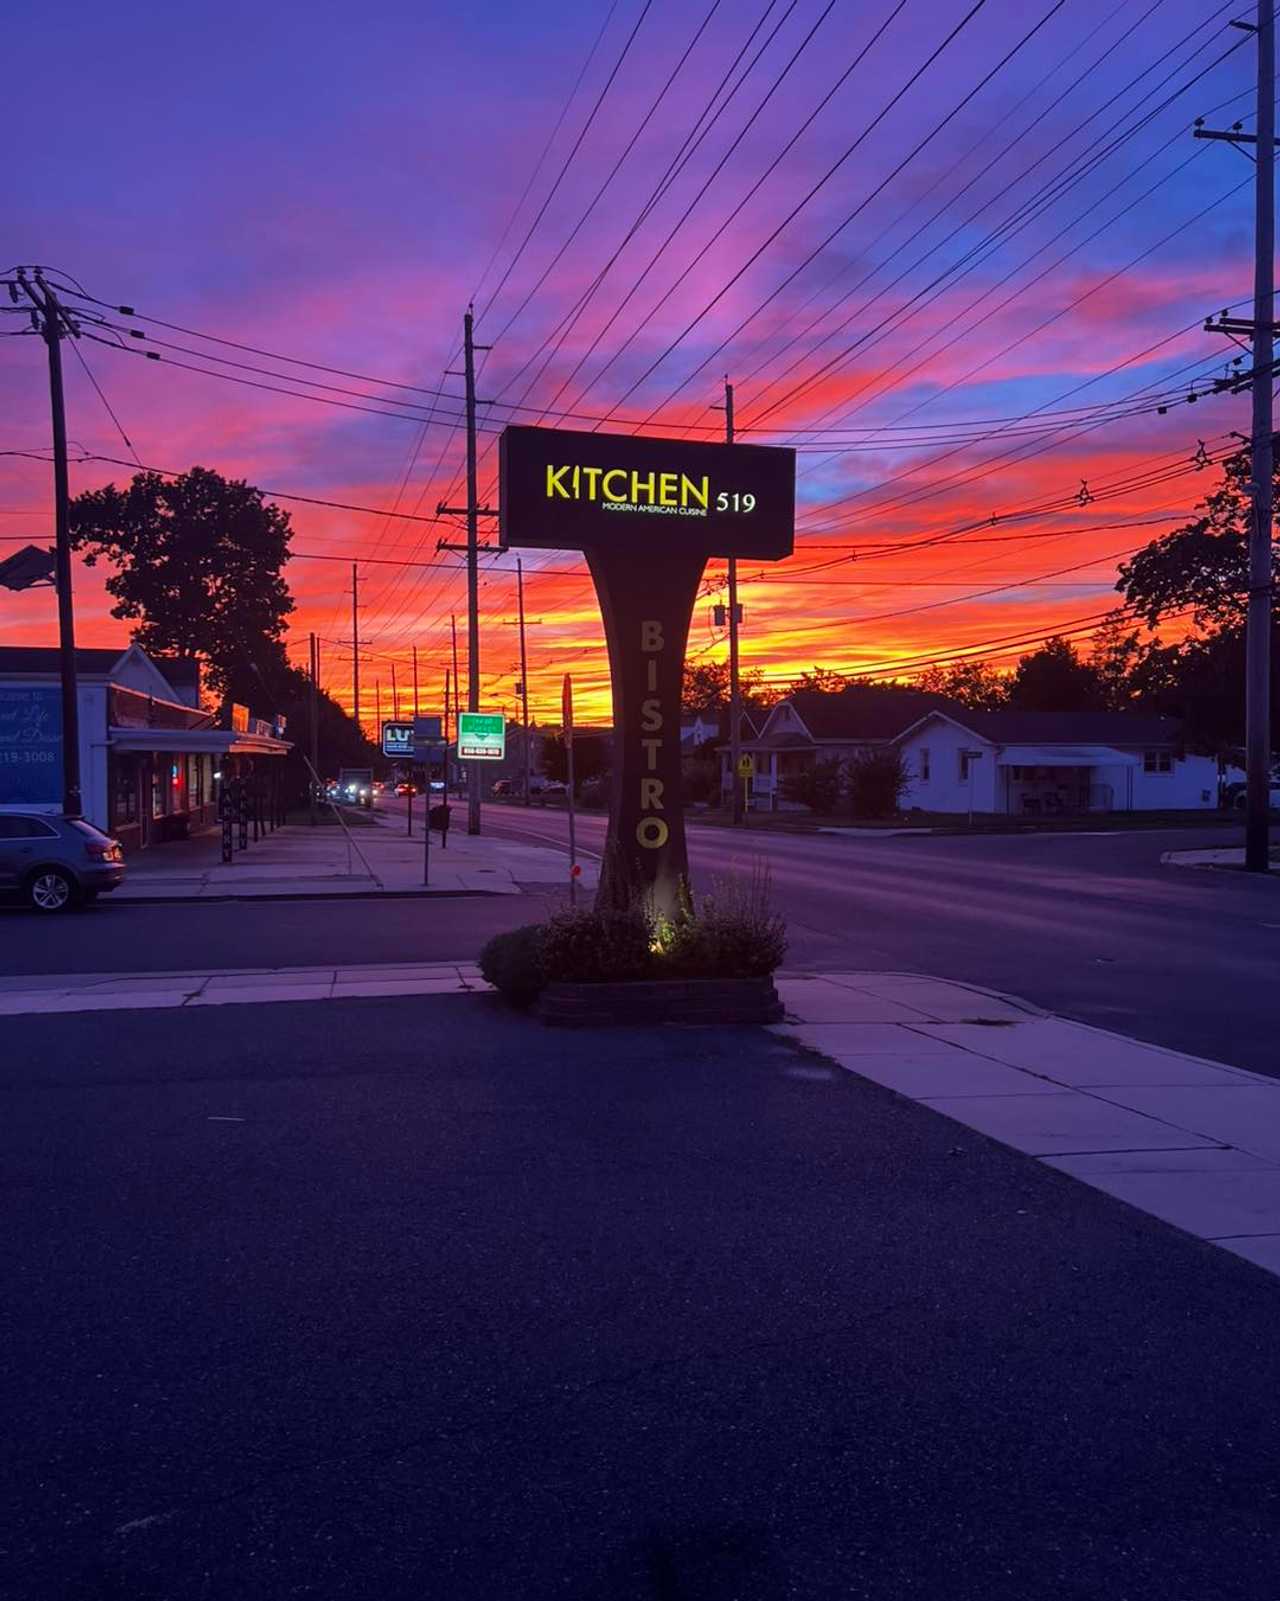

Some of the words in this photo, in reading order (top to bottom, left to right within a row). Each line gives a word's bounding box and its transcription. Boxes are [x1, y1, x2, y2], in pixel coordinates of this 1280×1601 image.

[546, 464, 709, 507] KITCHEN
[716, 492, 756, 513] 519
[602, 502, 637, 512] MODERN
[638, 504, 678, 515] AMERICAN
[679, 506, 708, 517] CUISINE
[636, 620, 669, 849] BISTRO
